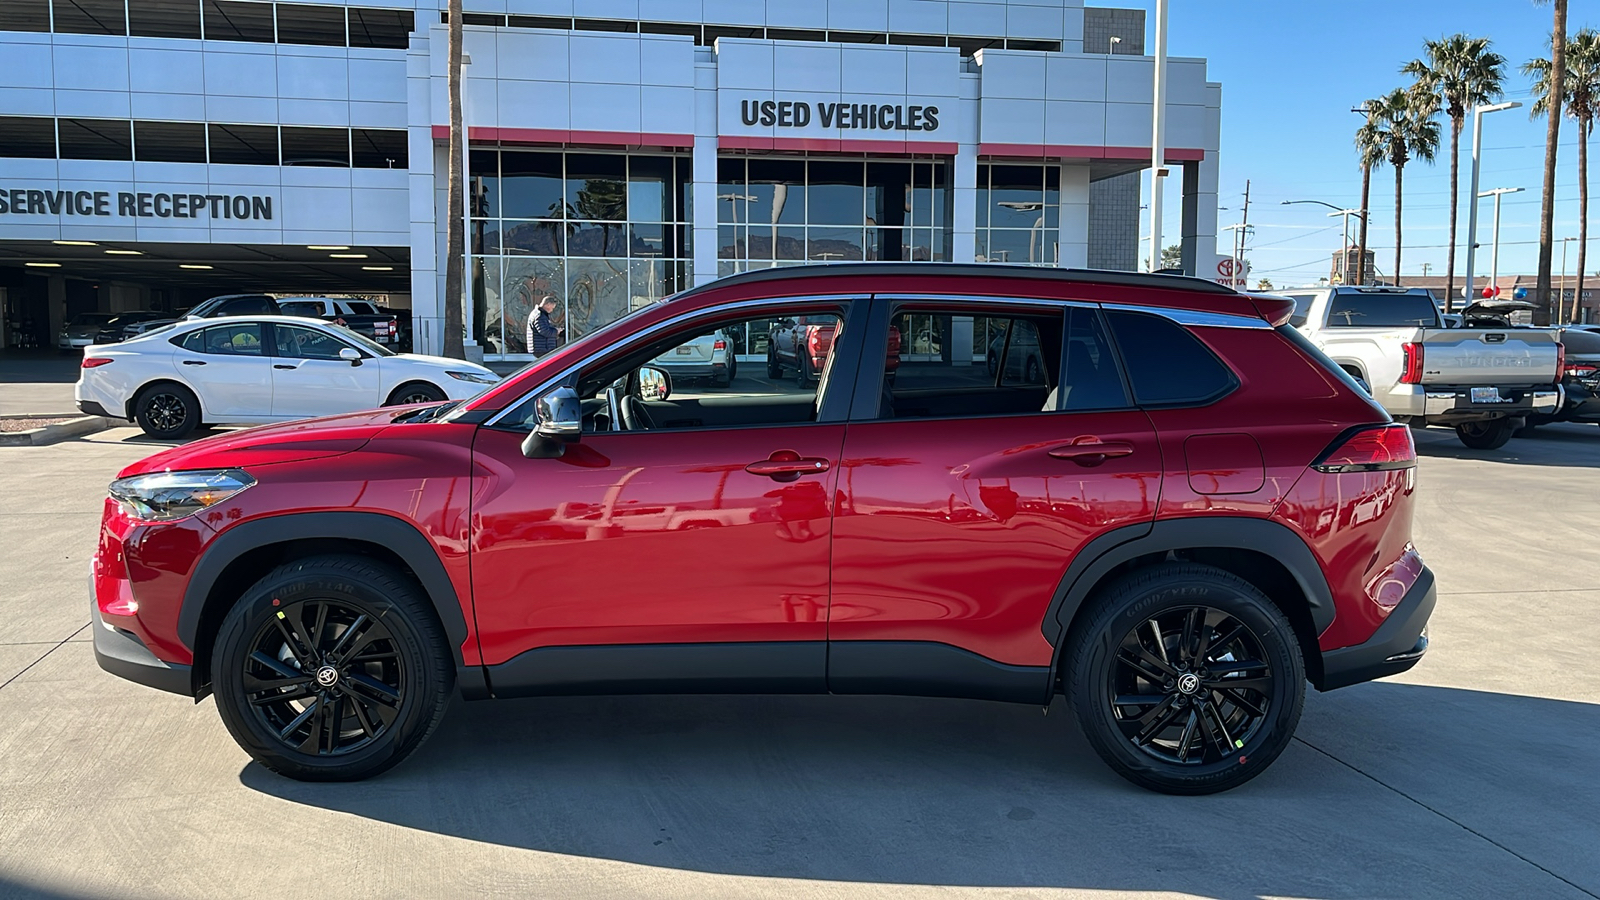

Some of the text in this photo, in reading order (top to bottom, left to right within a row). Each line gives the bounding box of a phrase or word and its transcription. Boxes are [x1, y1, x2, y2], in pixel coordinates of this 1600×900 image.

[741, 100, 939, 131] USED VEHICLES
[118, 192, 272, 220] RECEPTION
[1455, 356, 1532, 368] TUNDRA
